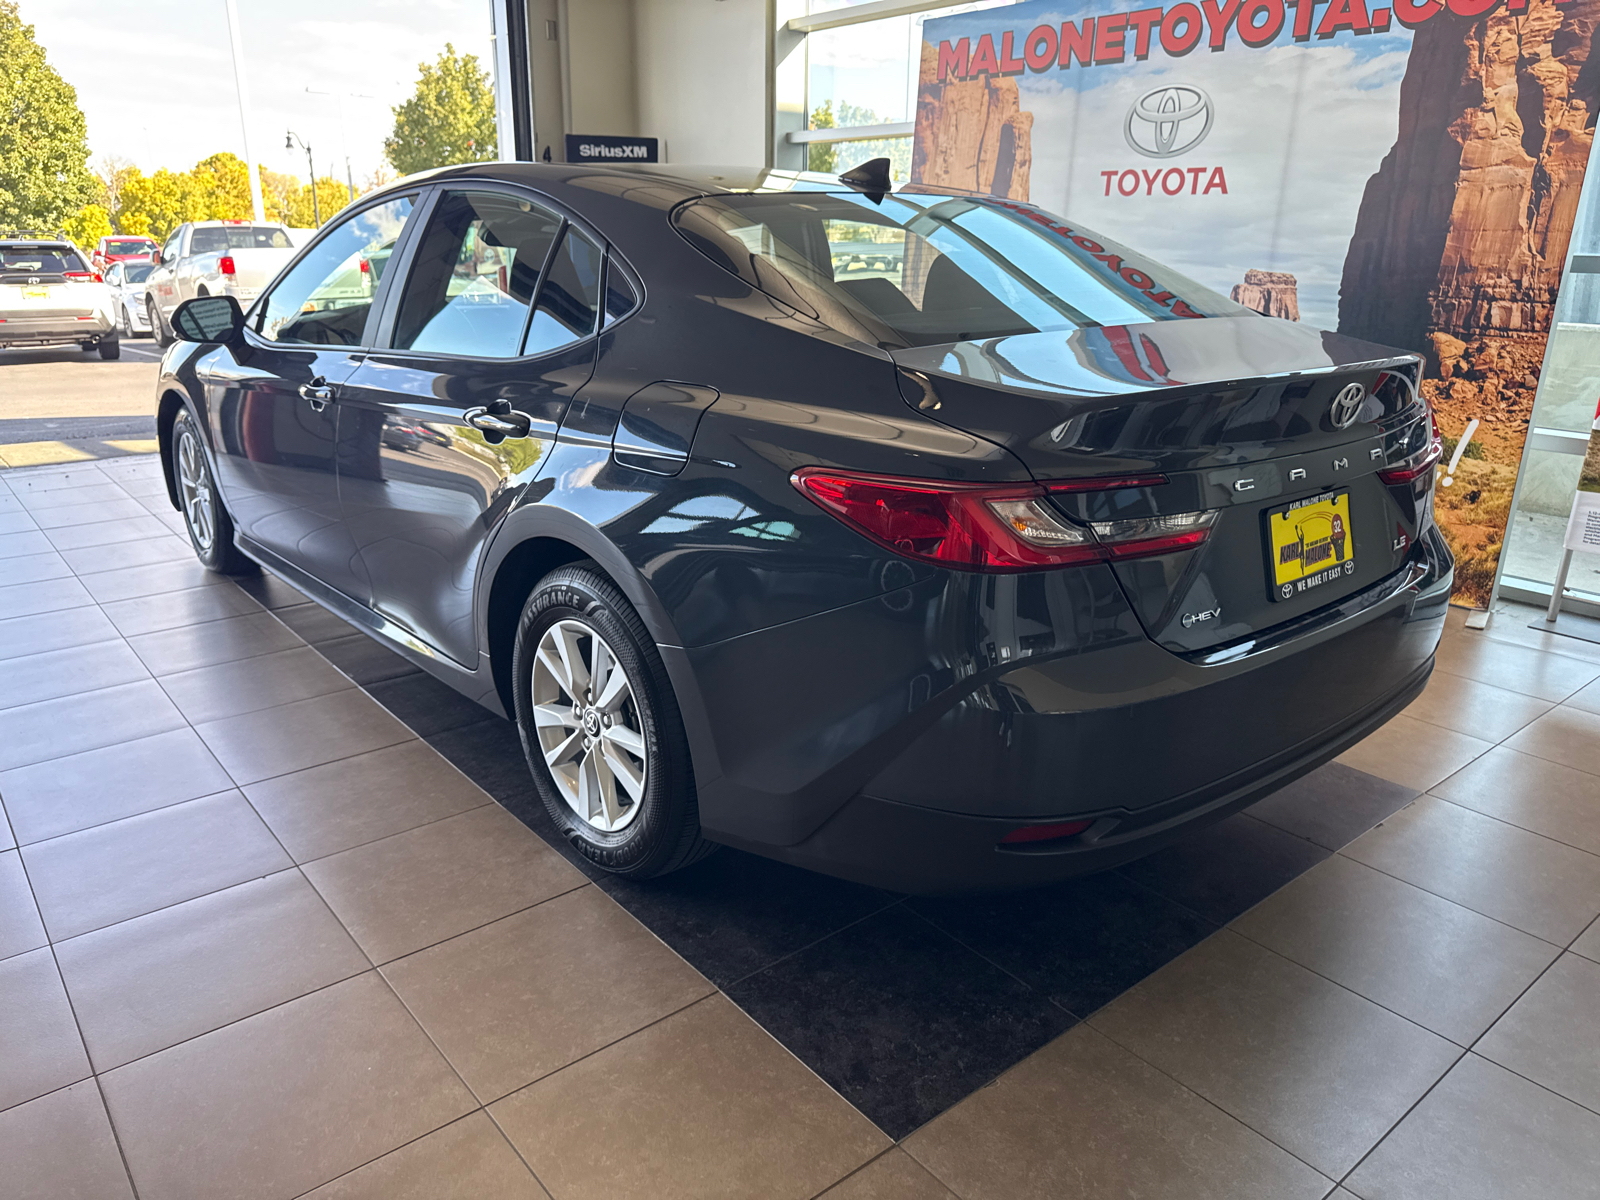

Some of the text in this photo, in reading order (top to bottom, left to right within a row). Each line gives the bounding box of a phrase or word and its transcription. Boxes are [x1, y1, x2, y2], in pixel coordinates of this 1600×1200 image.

[937, 0, 1572, 83] MALONETOYOTA.
[579, 144, 647, 158] SiriusXM
[1100, 166, 1228, 197] TOYOTA
[1289, 491, 1334, 511] KARL MALONE TOYOTA
[1333, 520, 1342, 533] 32
[1279, 541, 1300, 565] KARL
[1305, 541, 1332, 567] MALONE
[1393, 535, 1406, 551] LE
[1296, 567, 1341, 592] WE MAKE IT EASY
[524, 591, 580, 630] ASSURANCE
[577, 835, 643, 866] GOODYEAR
